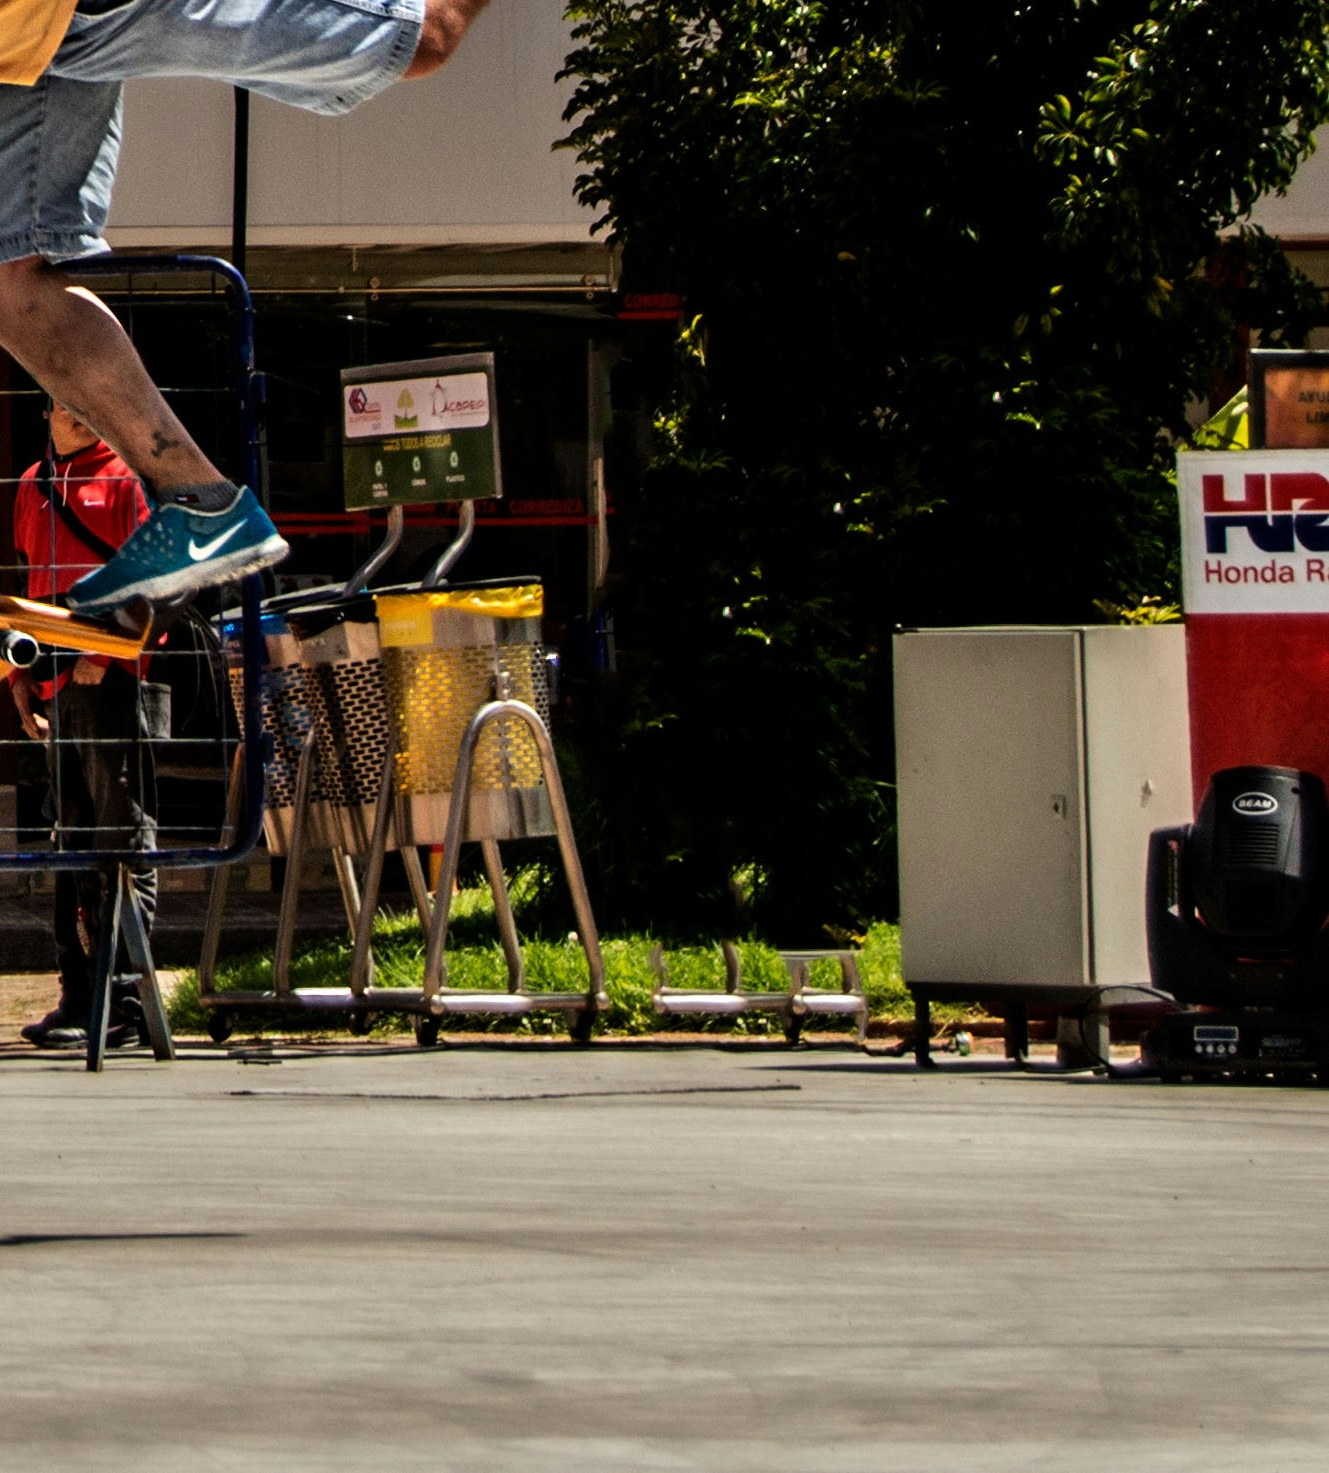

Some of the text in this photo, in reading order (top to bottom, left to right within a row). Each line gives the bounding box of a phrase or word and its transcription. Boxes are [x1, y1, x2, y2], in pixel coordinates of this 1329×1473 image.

[1202, 472, 1329, 554] HR
[1204, 559, 1294, 584] Honda
[1238, 798, 1273, 809] BEAM
